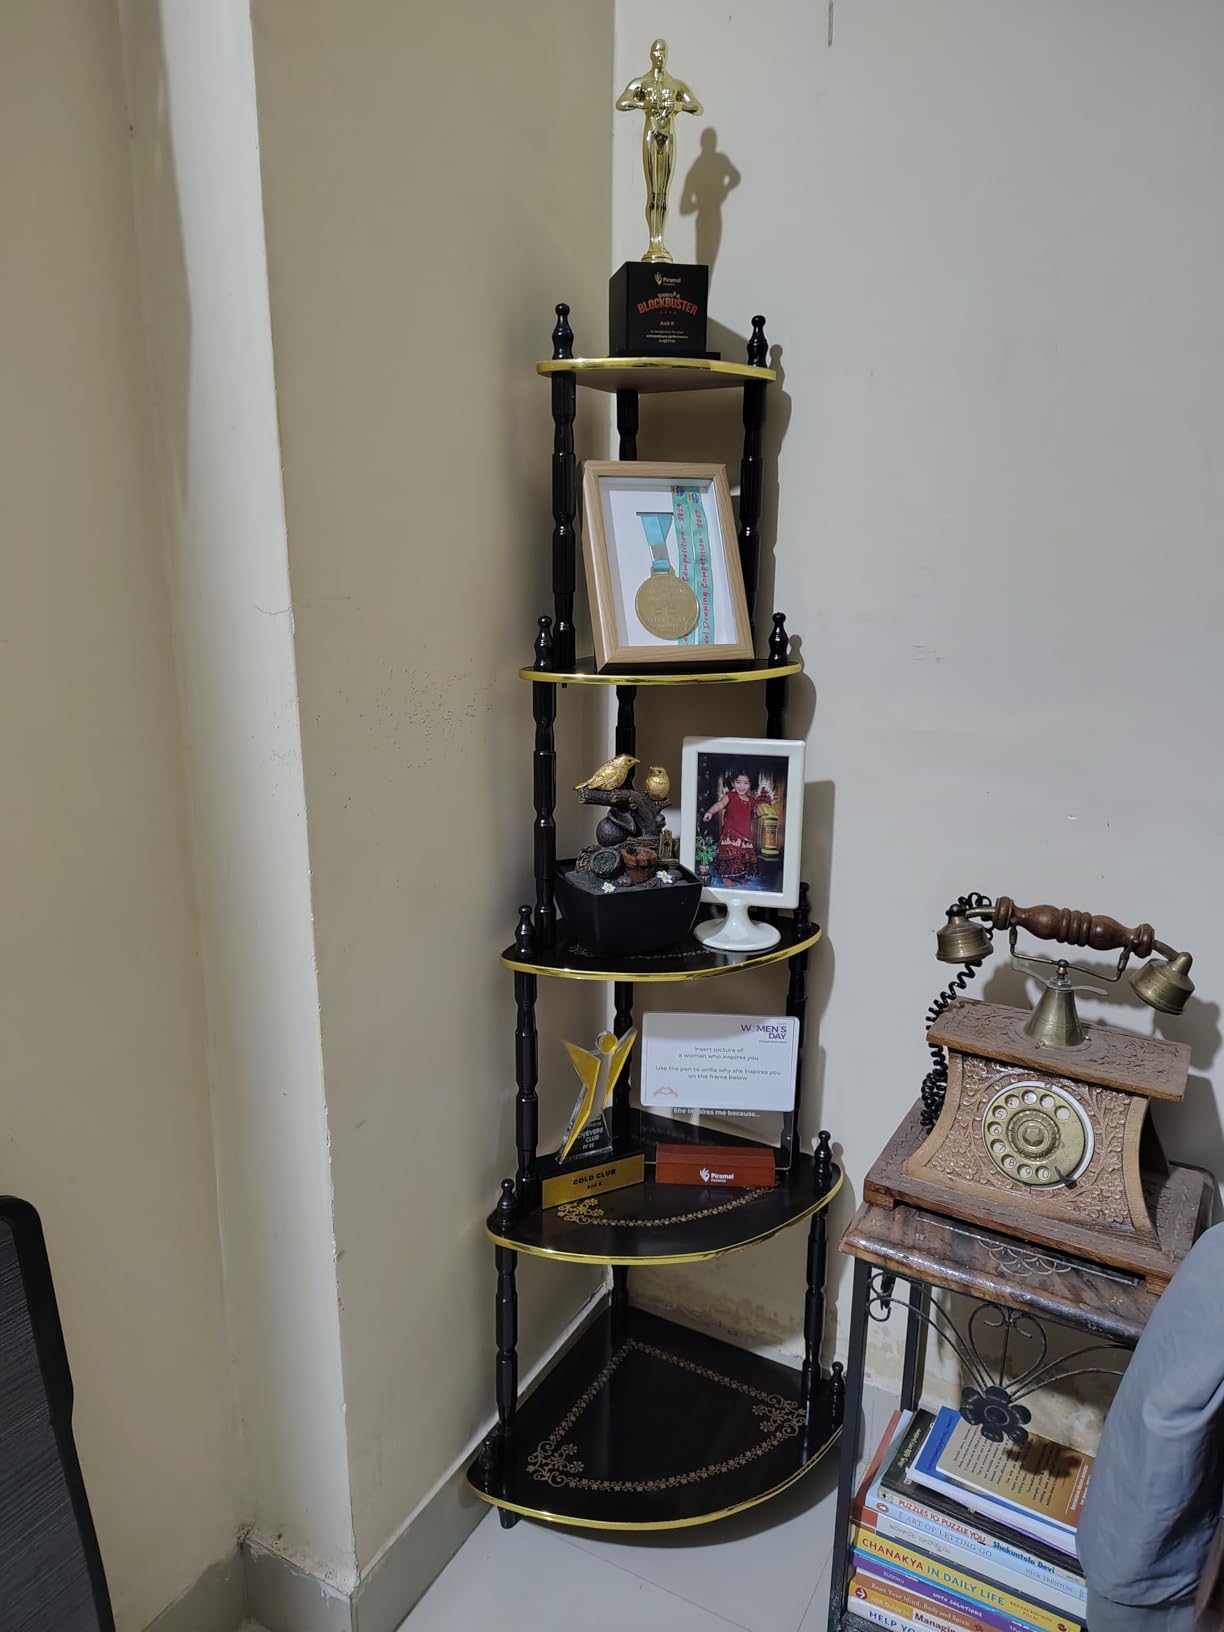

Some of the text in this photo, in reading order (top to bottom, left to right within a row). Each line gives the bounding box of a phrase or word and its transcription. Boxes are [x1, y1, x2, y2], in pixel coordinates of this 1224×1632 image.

[636, 298, 698, 316] BLOCKBUSTER
[681, 532, 690, 582] Competition
[699, 538, 708, 588] Competition
[585, 1134, 600, 1143] CLUB
[994, 1125, 999, 1134] 6
[573, 1169, 616, 1185] GOLD CLUB
[1025, 1168, 1031, 1176] 9
[899, 1500, 928, 1517] PUZZLES
[930, 1514, 939, 1522] TO
[941, 1519, 968, 1534] PUZZLE
[969, 1530, 986, 1543] YOU
[906, 1517, 992, 1558] ART OF LETTING GO
[992, 1541, 1055, 1574] Shakuntala Devi
[862, 1538, 924, 1571] CHANAKYA
[927, 1566, 940, 1577] IN
[943, 1572, 977, 1593] DAILY
[980, 1589, 1005, 1606] LIFE
[883, 1571, 905, 1584] SUDOKU
[1025, 1568, 1042, 1579] NICK
[888, 1588, 902, 1598] Your
[923, 1603, 938, 1615] Body
[950, 1598, 982, 1617] SOLUTIONS
[869, 1610, 897, 1627] HELP
